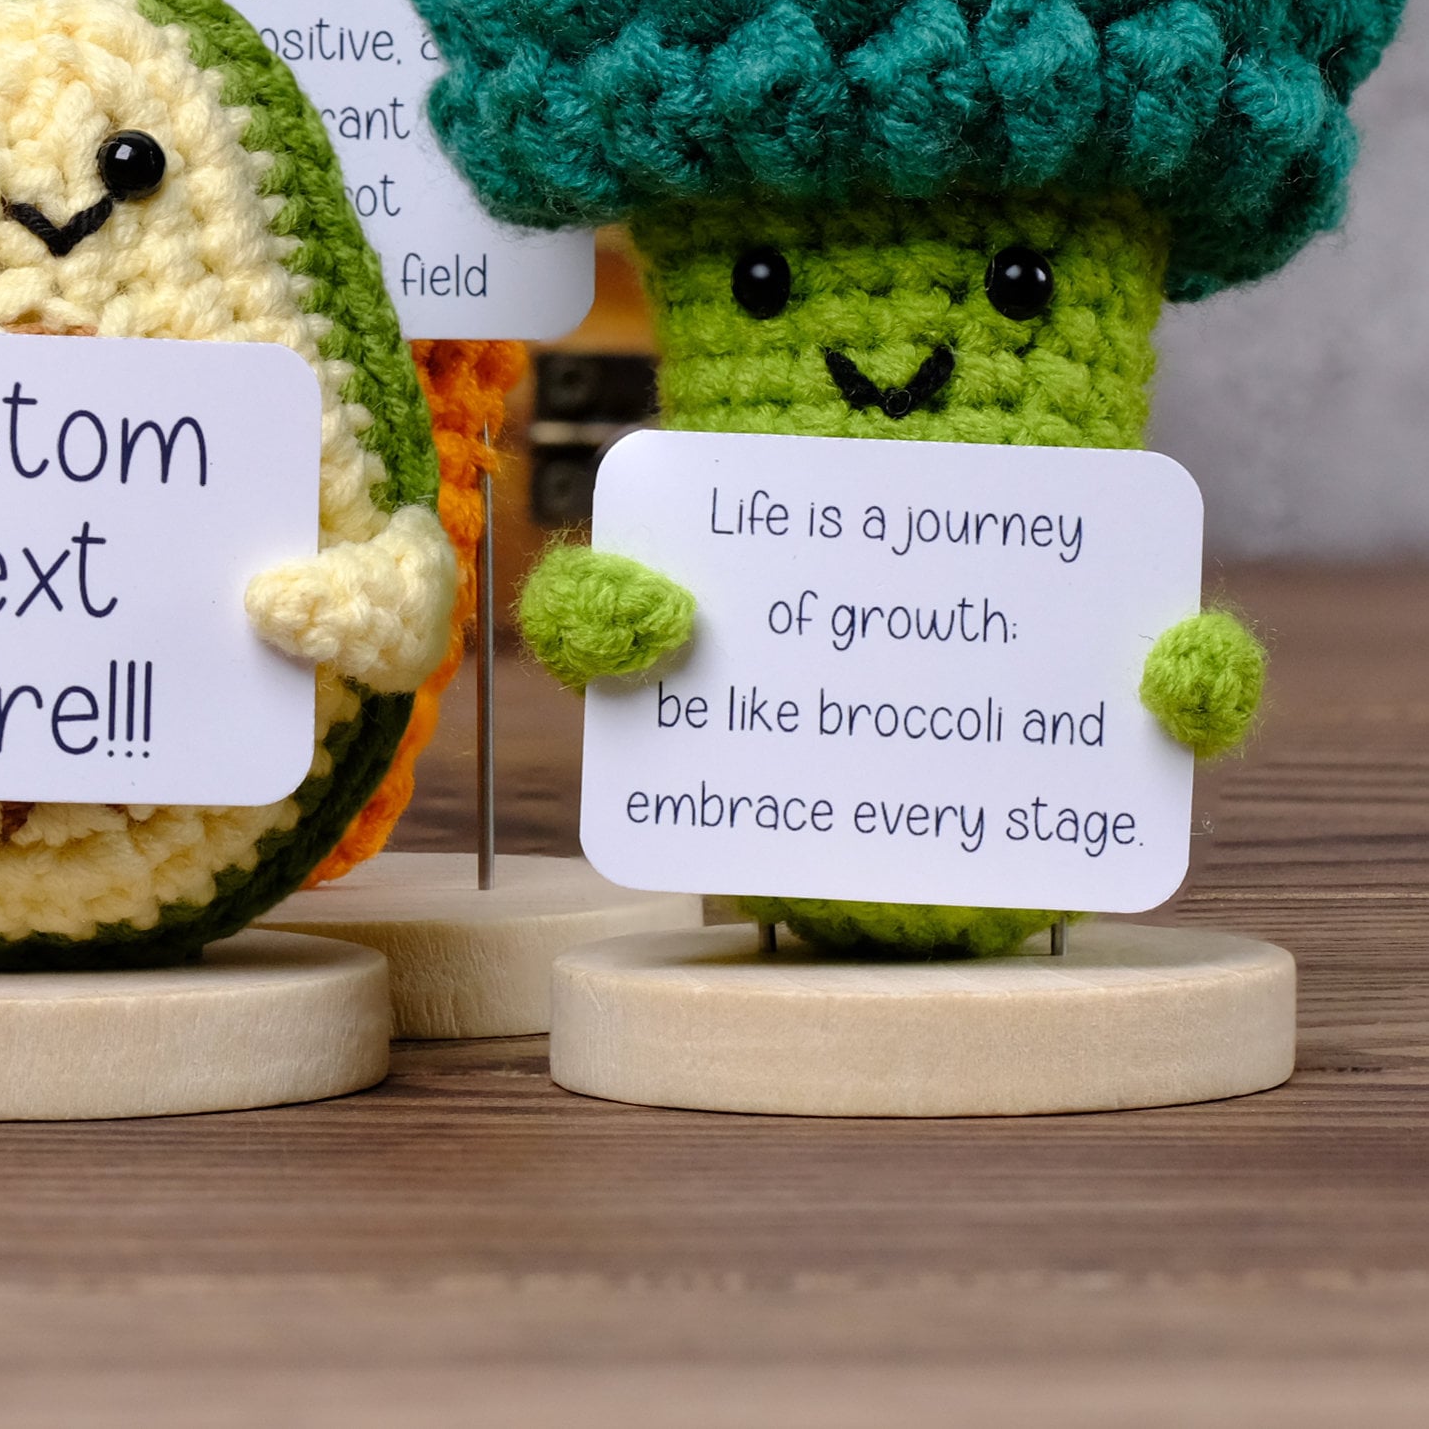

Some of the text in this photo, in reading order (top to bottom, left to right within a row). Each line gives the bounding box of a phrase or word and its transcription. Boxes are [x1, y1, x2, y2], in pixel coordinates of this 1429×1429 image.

[401, 253, 487, 298] field
[710, 486, 1083, 564] Life is a journey
[767, 589, 819, 636] of
[657, 681, 1105, 748] be like broccoli and
[626, 780, 1144, 858] embrace every stage.
